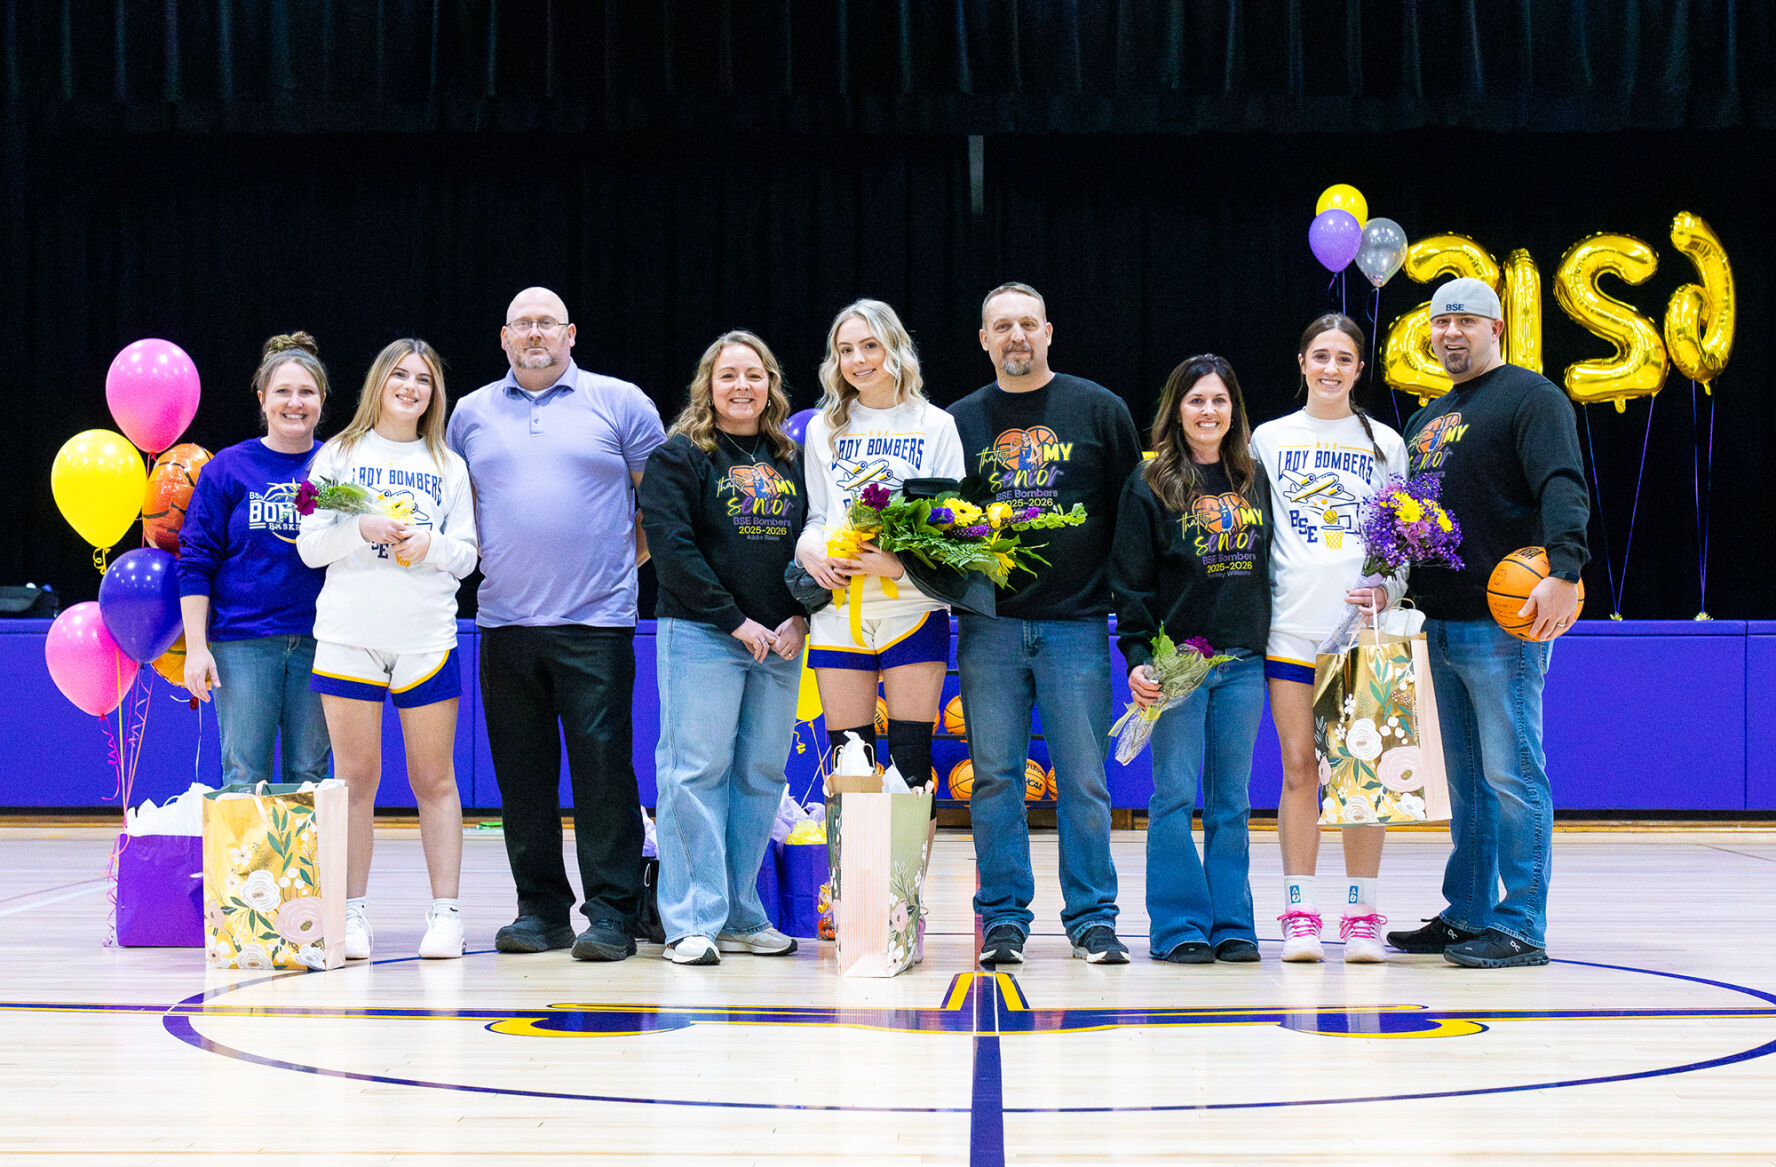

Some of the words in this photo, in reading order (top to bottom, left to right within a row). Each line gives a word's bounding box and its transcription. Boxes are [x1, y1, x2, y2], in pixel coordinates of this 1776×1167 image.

[1446, 303, 1464, 312] BSE
[1443, 423, 1470, 443] MY
[867, 438, 925, 471] BOMBERS
[1043, 442, 1073, 462] MY
[1409, 445, 1453, 471] enior
[1278, 450, 1309, 481] LADY
[1315, 450, 1374, 486] BOMBERS
[388, 469, 443, 507] BOMBERS
[774, 479, 797, 496] MY
[988, 465, 1064, 493] senior
[996, 491, 1012, 502] BSE
[1014, 488, 1058, 498] Bombers
[728, 496, 794, 517] senior
[1240, 507, 1264, 526] MY
[733, 516, 751, 526] BSE
[753, 516, 791, 527] Bombers
[738, 525, 787, 536] 2025-2026
[1289, 510, 1318, 543] BSE
[1194, 529, 1260, 556] senior
[1203, 555, 1216, 566] BSE
[1207, 560, 1253, 574] 2025-2026
